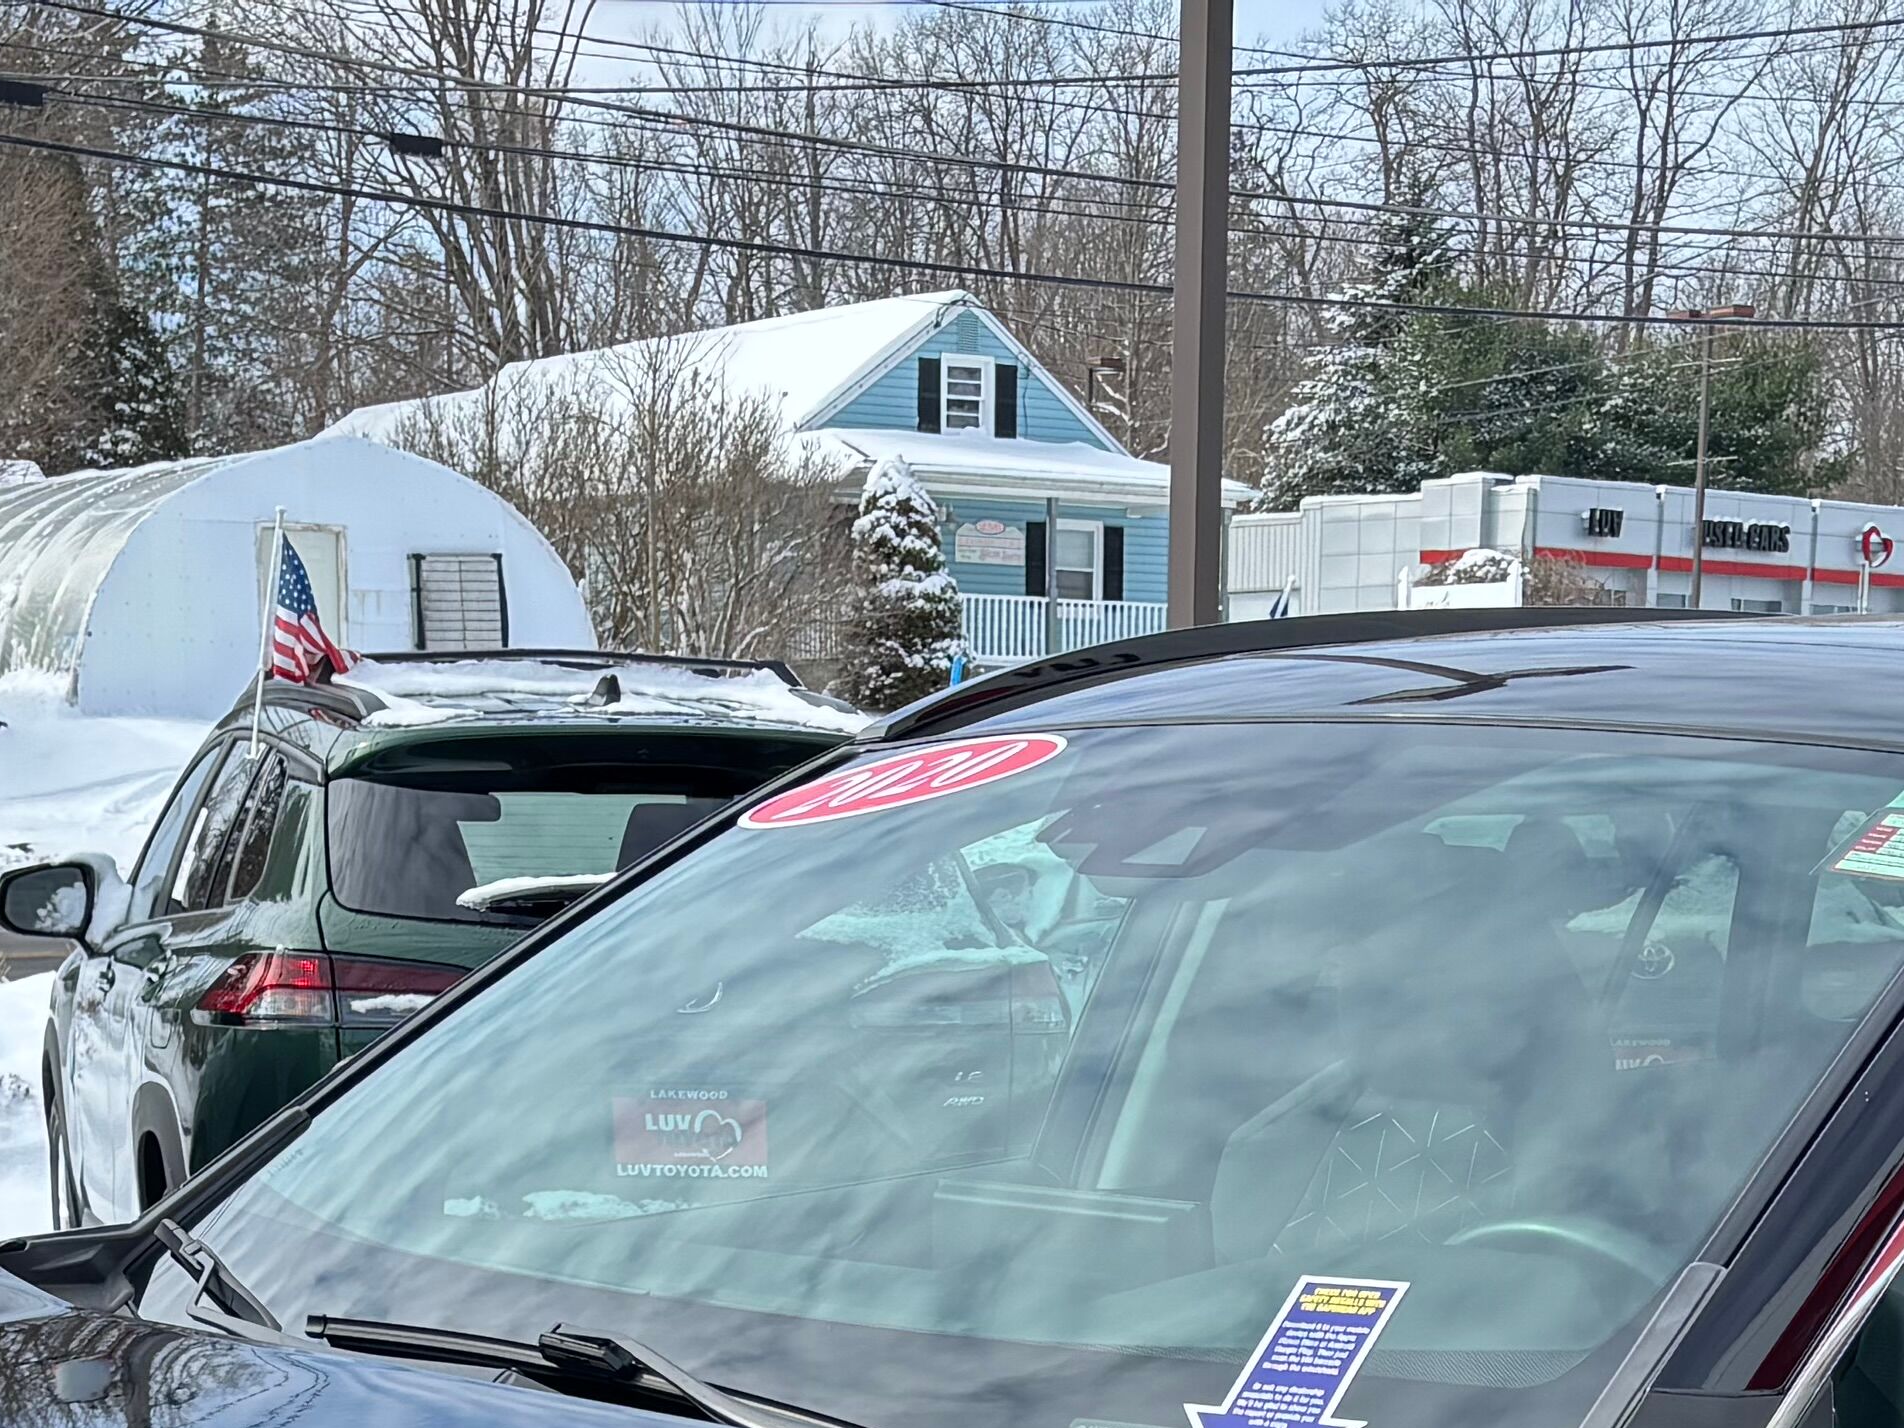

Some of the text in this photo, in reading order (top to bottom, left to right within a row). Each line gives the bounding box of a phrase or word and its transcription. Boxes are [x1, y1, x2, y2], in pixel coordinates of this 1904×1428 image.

[1589, 508, 1624, 538] LUV
[770, 740, 1030, 821] 2020
[650, 1089, 729, 1100] LAKEWOOD
[645, 1113, 692, 1131] LUV
[616, 1163, 769, 1178] LUVTOYOTA.COM
